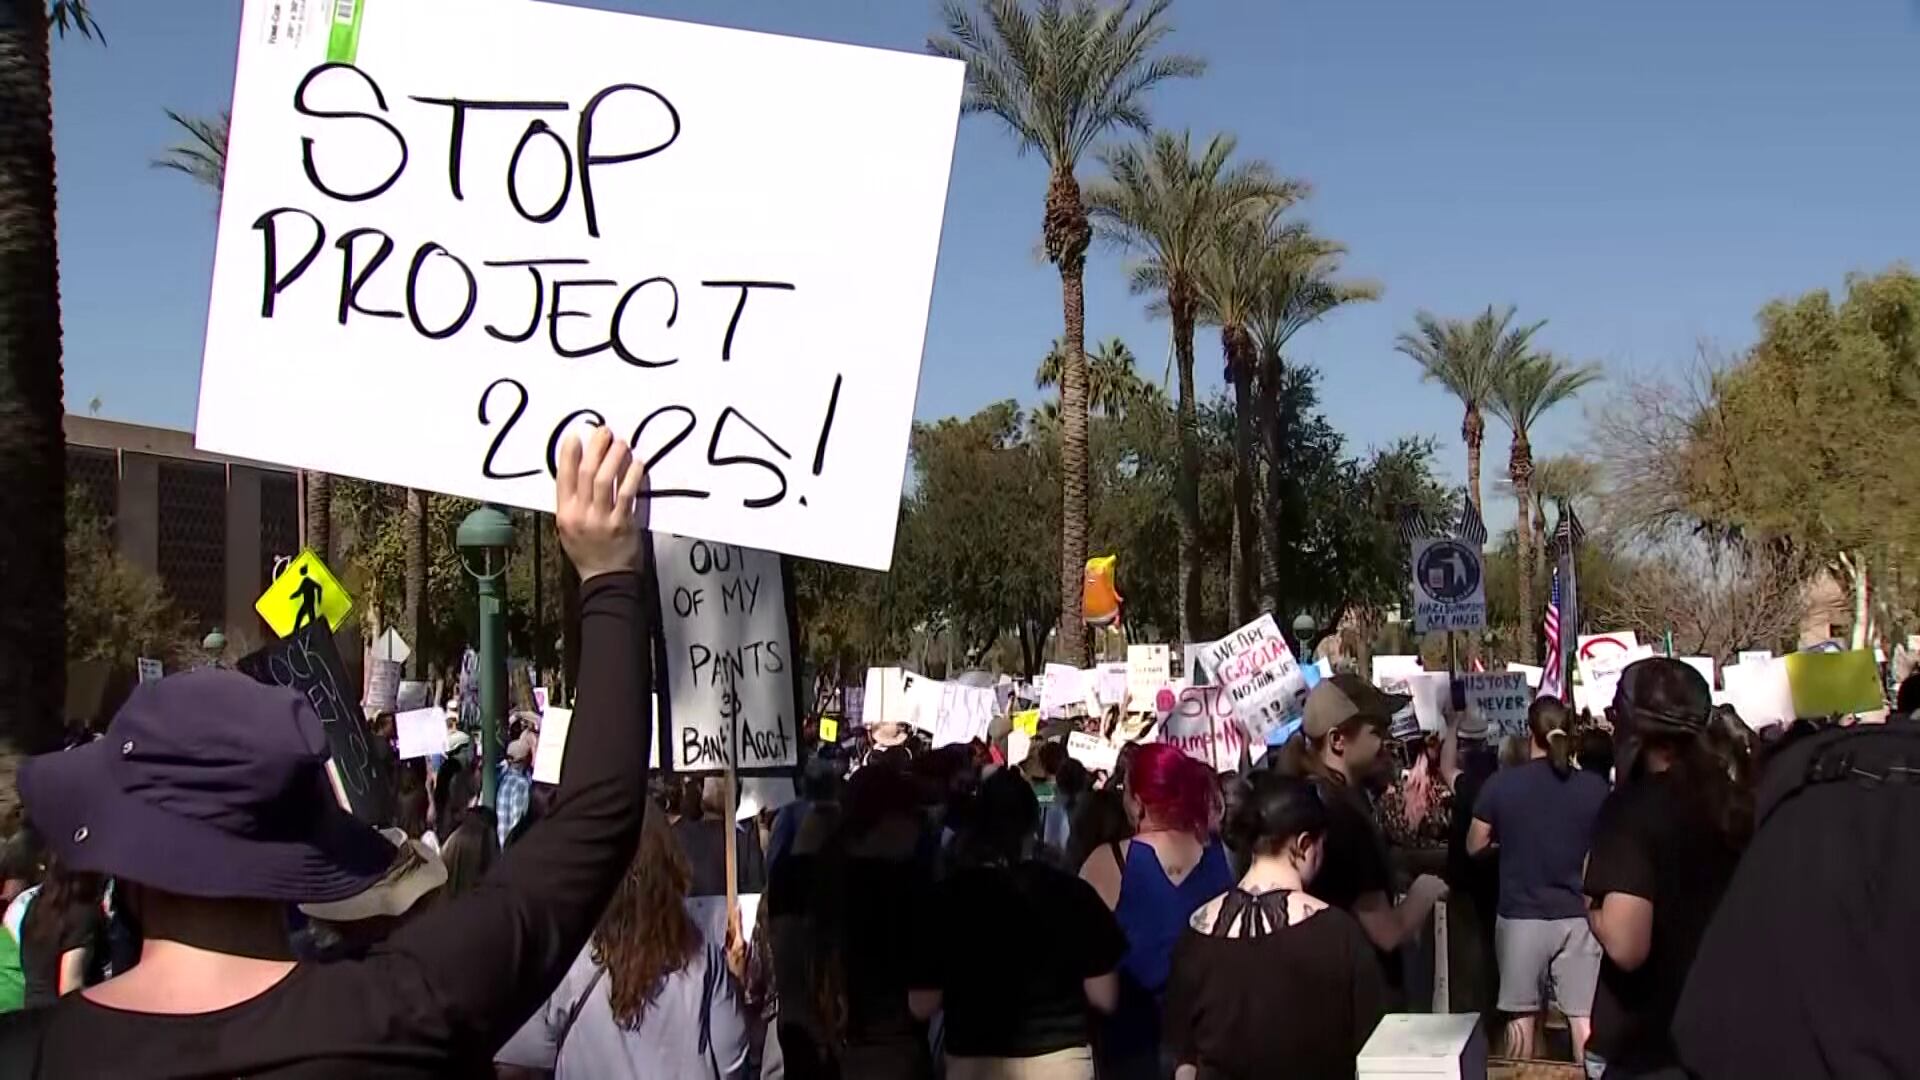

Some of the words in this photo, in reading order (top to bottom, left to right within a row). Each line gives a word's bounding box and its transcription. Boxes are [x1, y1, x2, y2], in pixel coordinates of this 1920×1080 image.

[294, 62, 681, 238] STOP
[253, 207, 796, 368] PROJECT
[690, 540, 744, 575] OUT
[673, 586, 704, 618] OF
[721, 573, 760, 617] MY
[689, 641, 784, 688] PANTS
[1180, 686, 1234, 717] STO
[1477, 695, 1525, 712] NEVER
